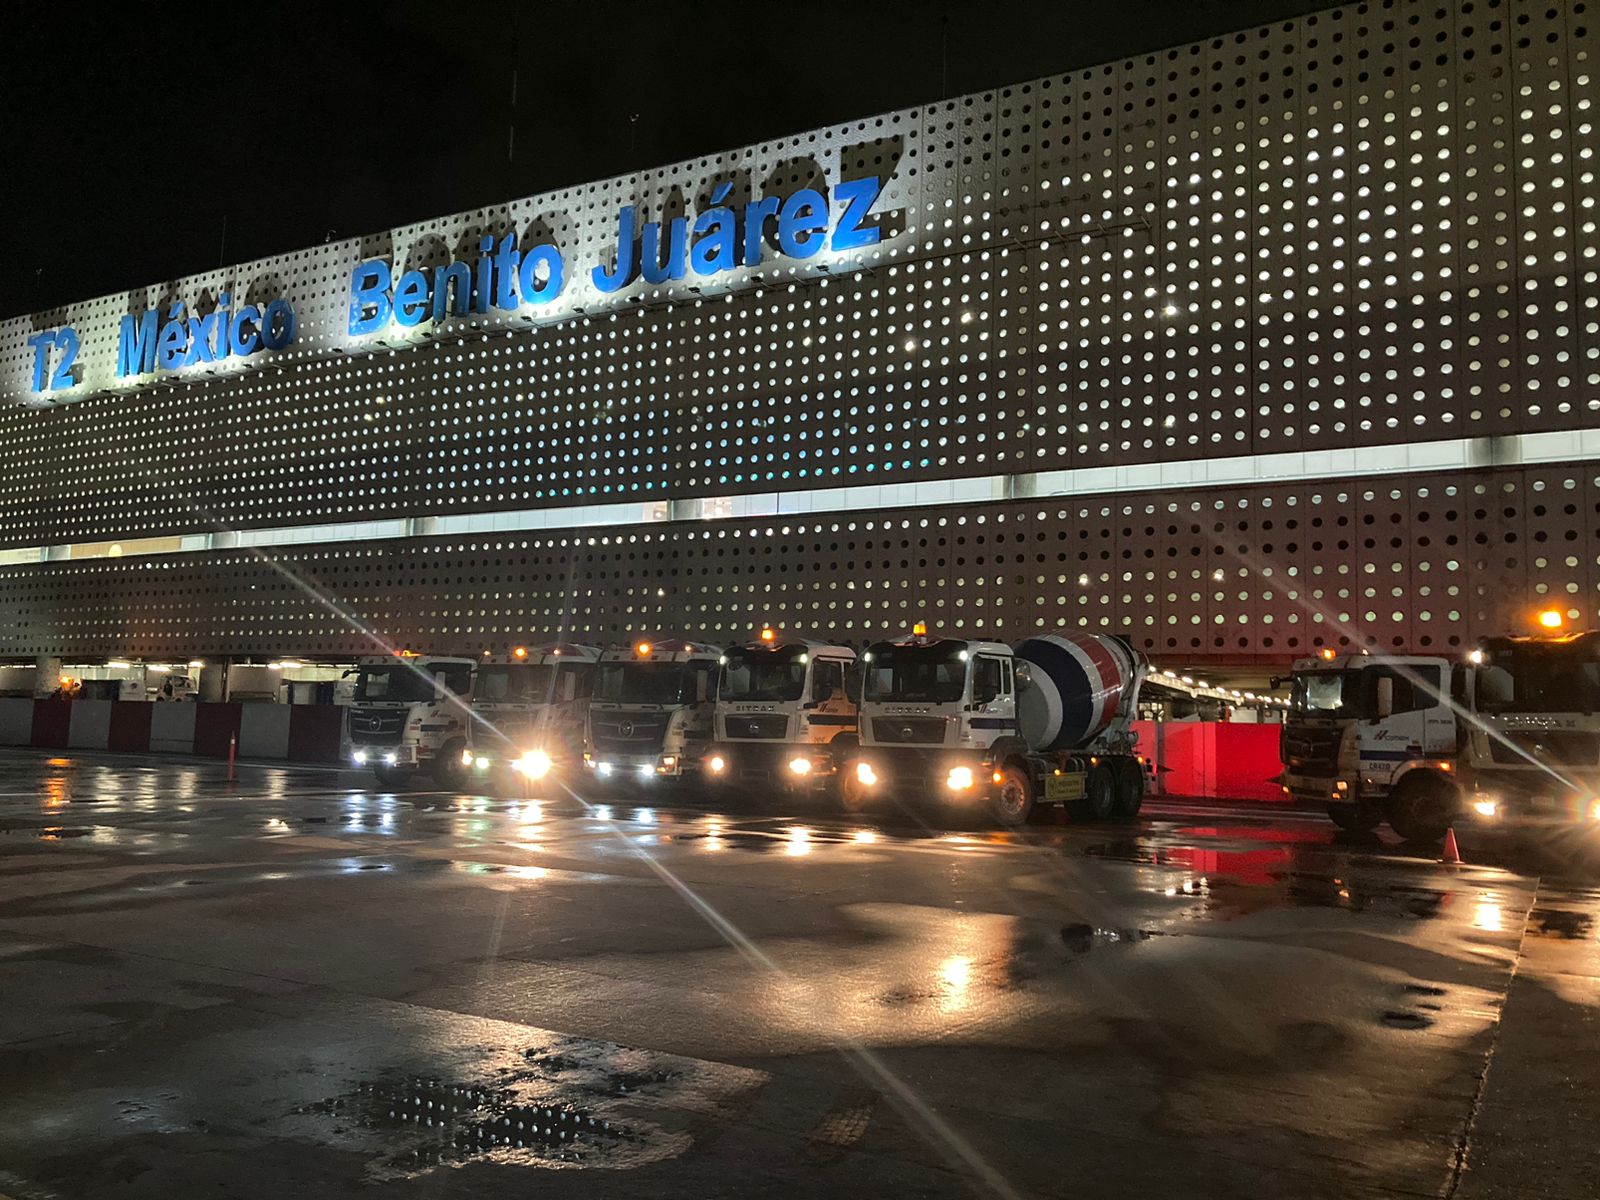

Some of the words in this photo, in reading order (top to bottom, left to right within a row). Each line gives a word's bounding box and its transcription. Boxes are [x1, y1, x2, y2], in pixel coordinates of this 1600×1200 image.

[27, 326, 81, 393] T2
[116, 292, 296, 379] México
[347, 233, 565, 337] Benito
[591, 175, 881, 294] Juárez
